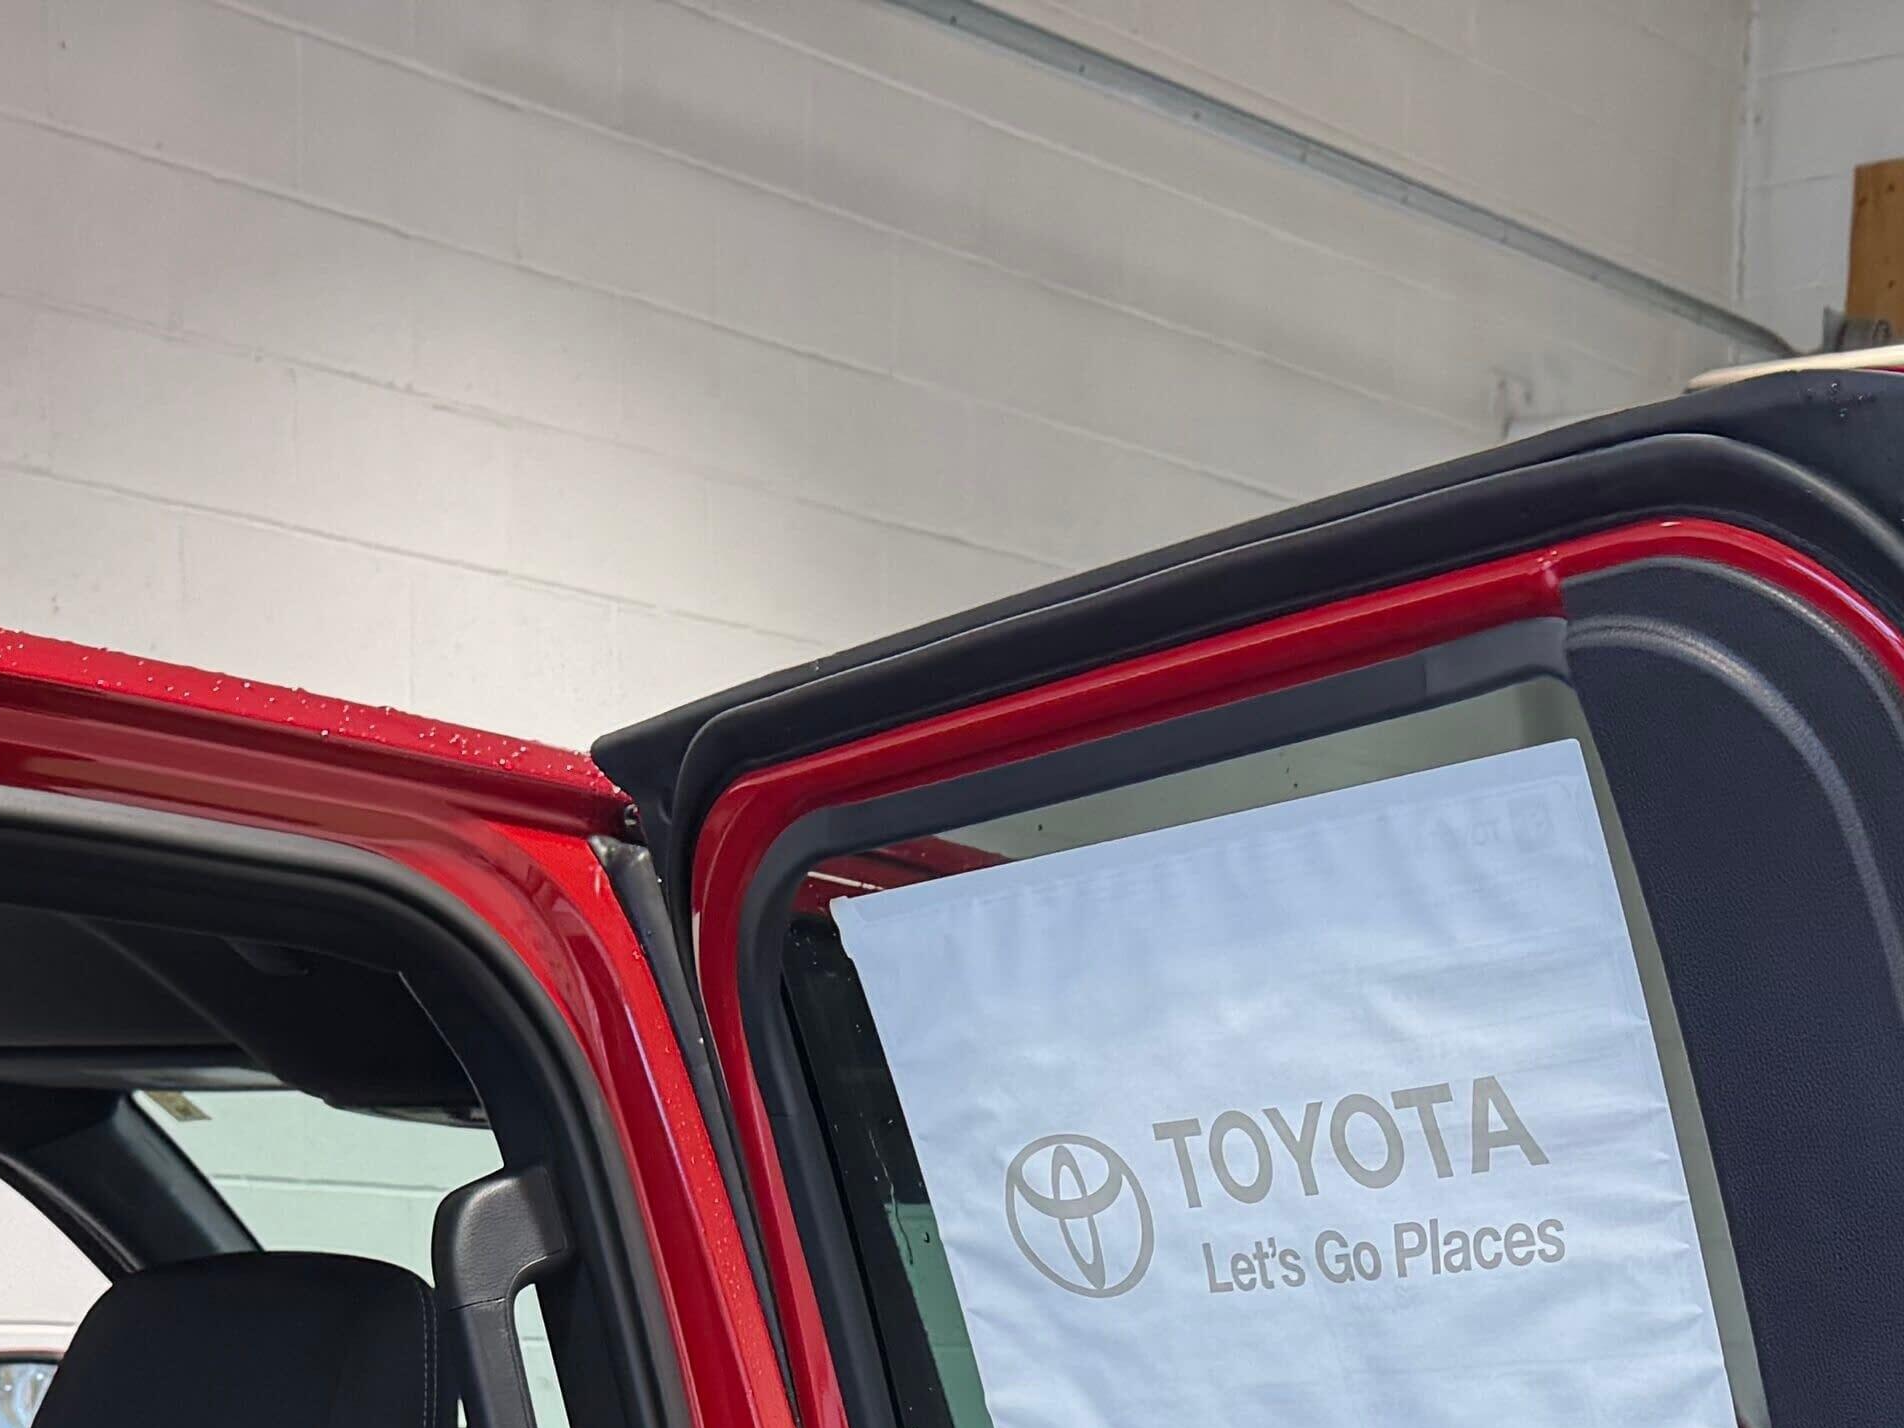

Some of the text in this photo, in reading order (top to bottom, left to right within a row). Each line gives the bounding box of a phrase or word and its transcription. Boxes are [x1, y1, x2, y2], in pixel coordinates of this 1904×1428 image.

[1151, 1075, 1550, 1209] TOYOTA
[1202, 1218, 1566, 1295] Let's Go Places
